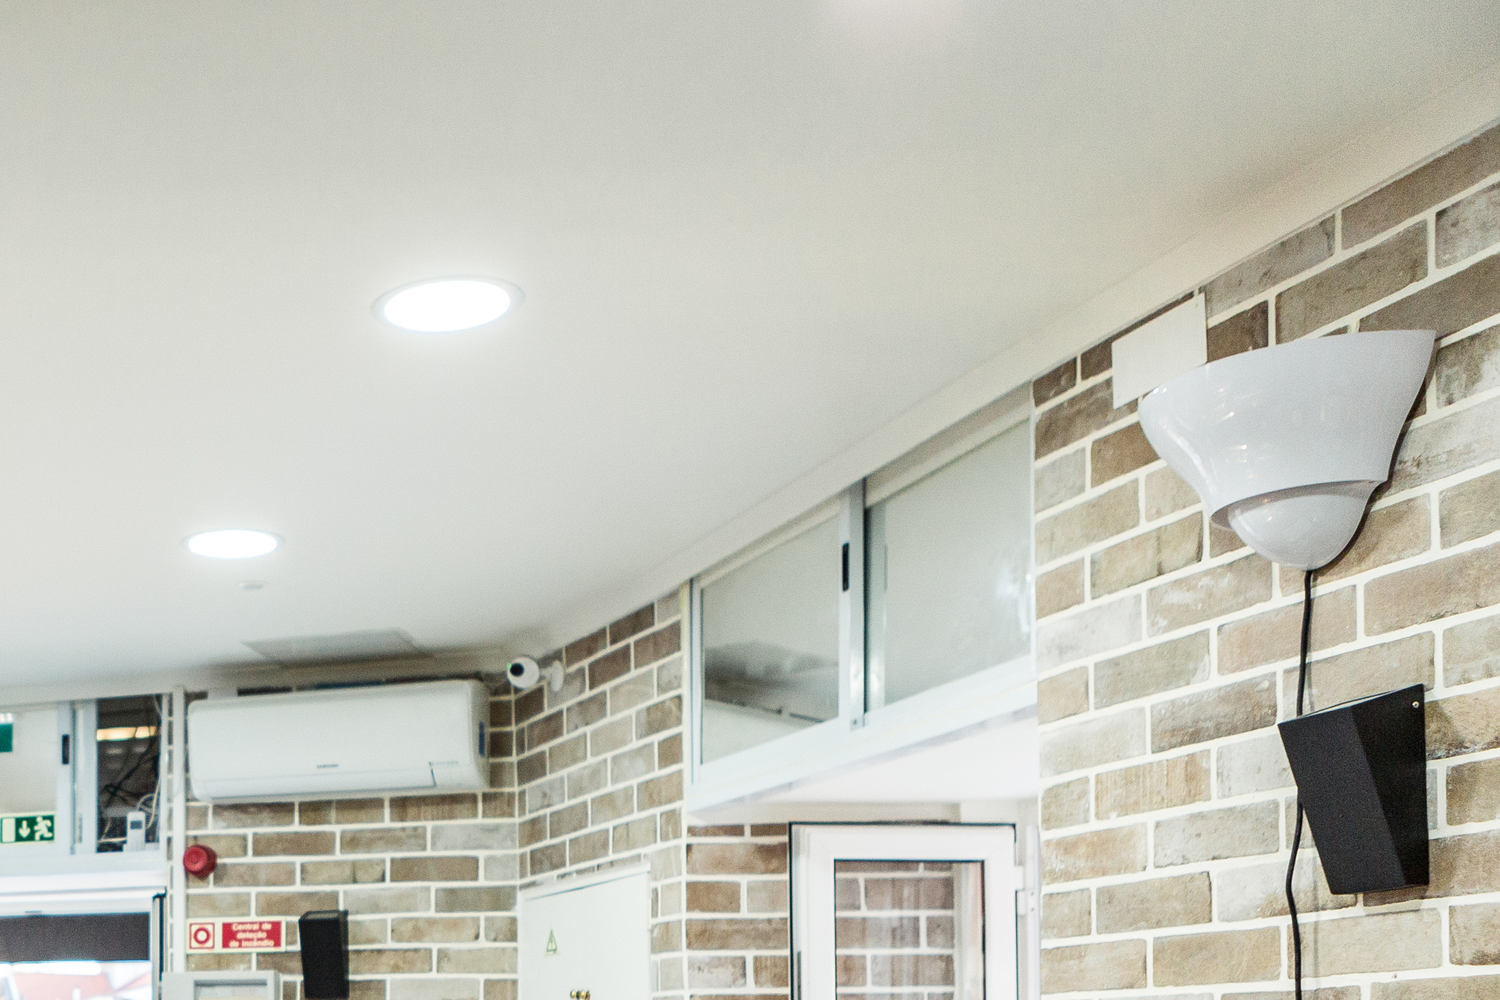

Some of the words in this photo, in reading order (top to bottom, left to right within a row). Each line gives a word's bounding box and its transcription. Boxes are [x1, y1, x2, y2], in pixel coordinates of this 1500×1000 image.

[232, 923, 260, 931] Central
[261, 922, 272, 930] de
[236, 931, 267, 940] deteção
[229, 940, 240, 948] de
[241, 938, 275, 948] incêndio
